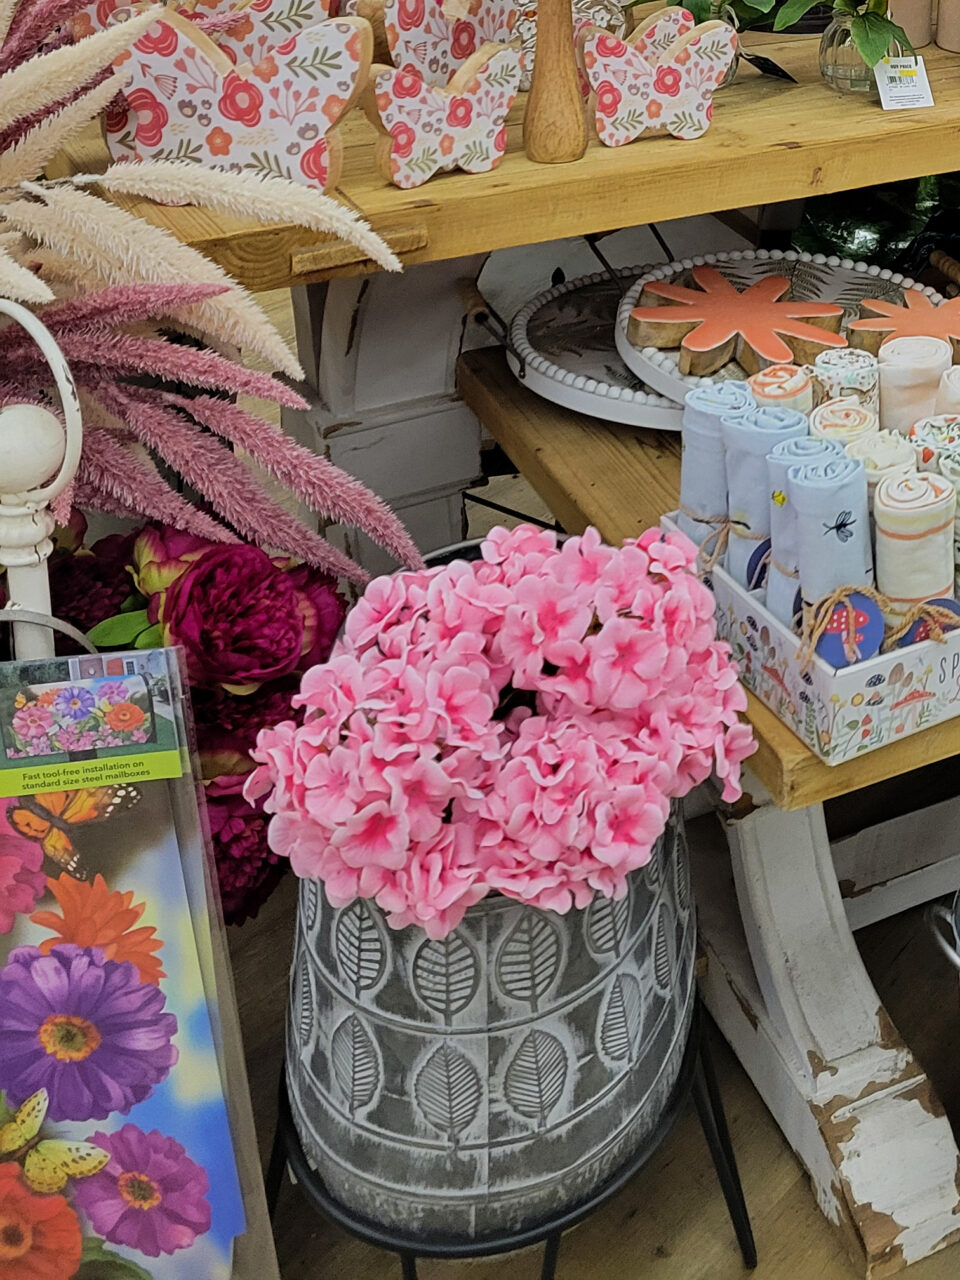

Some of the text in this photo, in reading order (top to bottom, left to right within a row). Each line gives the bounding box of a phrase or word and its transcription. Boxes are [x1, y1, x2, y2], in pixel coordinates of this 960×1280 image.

[22, 760, 145, 781] Fast tool-free installation on
[22, 768, 151, 790] standard size steel mailboxes
